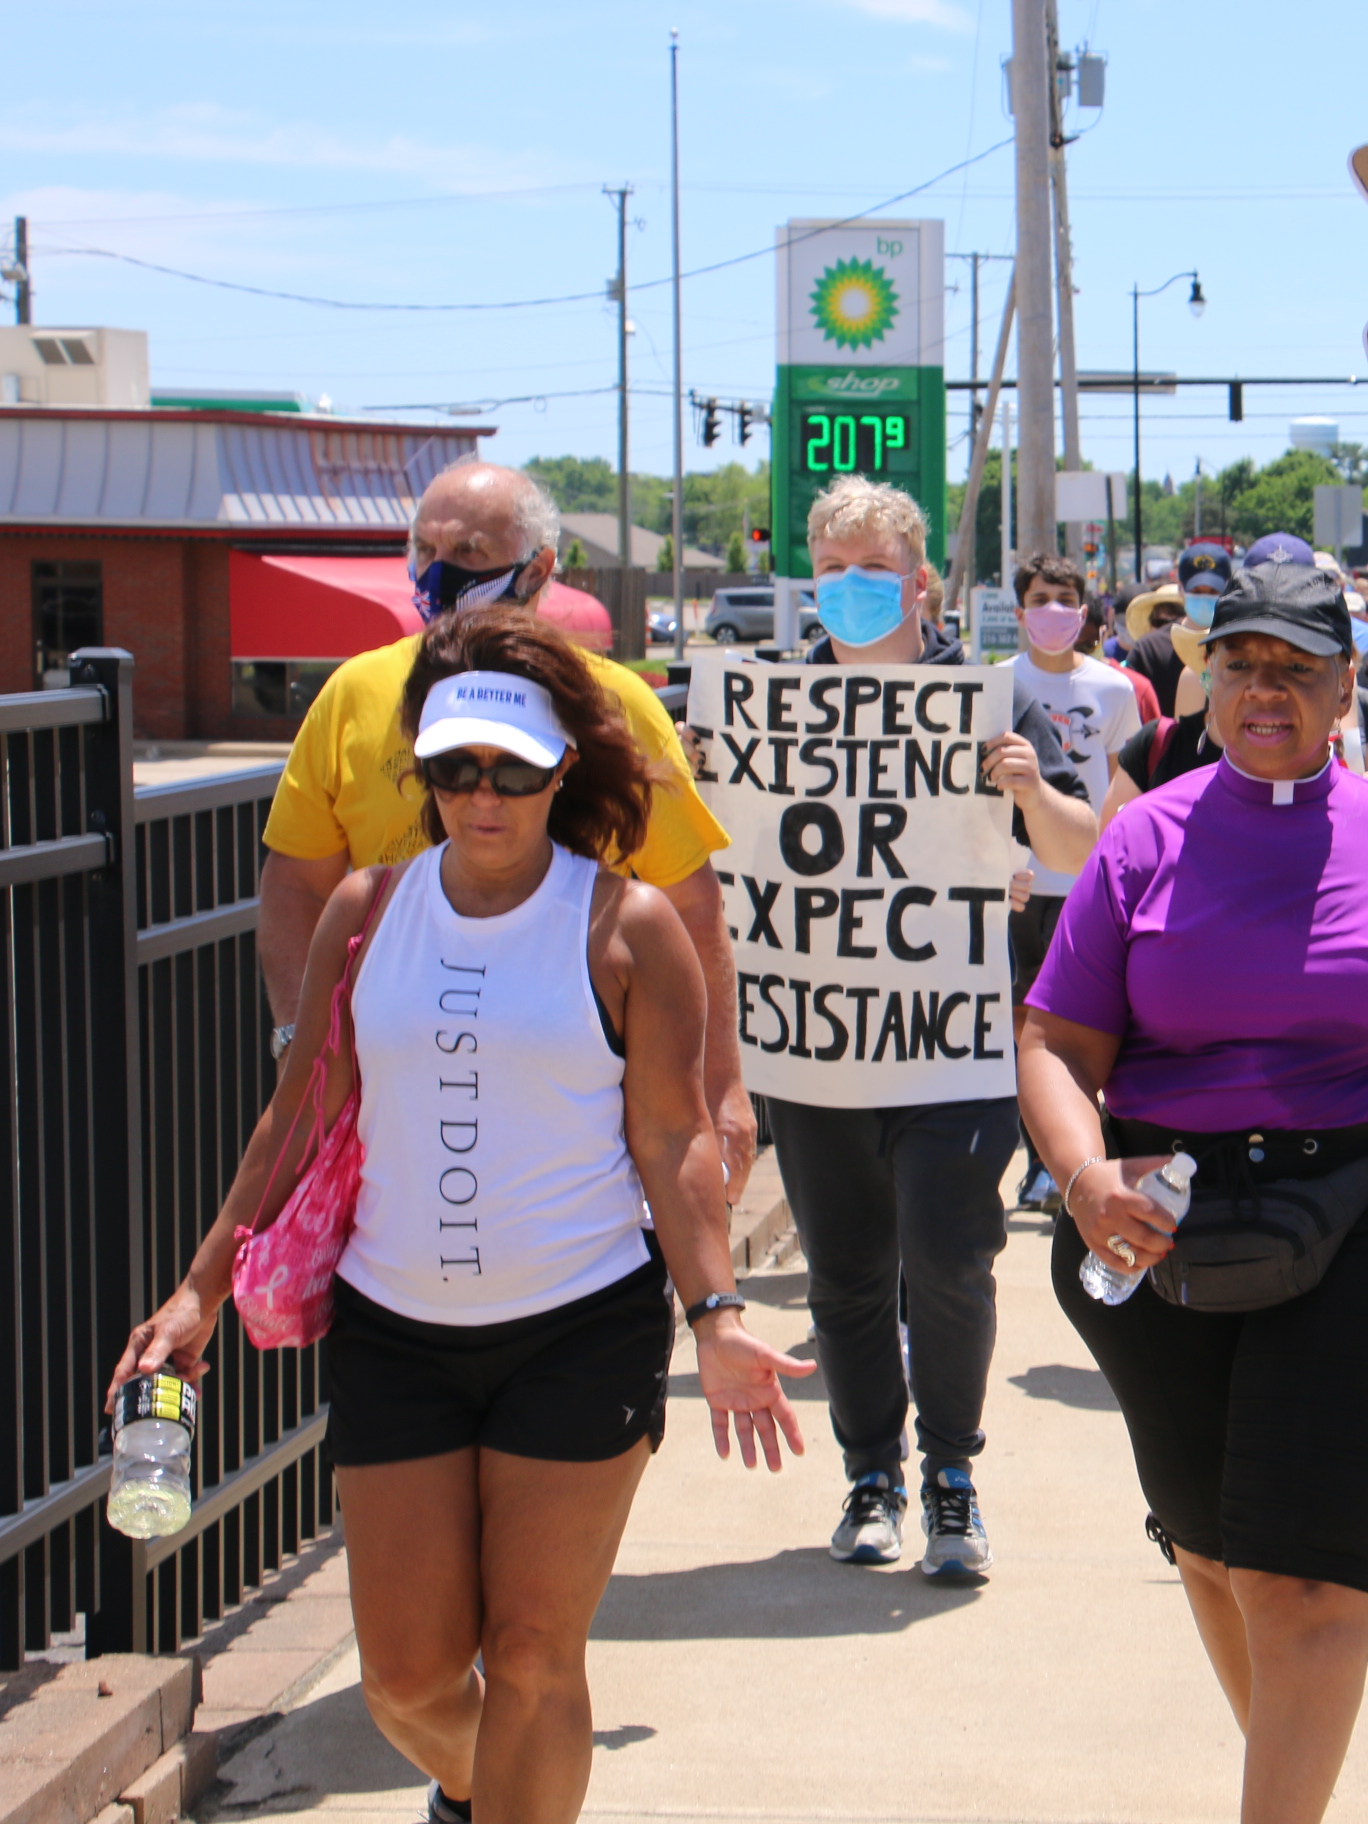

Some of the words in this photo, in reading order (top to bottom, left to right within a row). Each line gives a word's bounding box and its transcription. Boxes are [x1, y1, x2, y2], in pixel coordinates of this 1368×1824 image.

[877, 236, 904, 258] bp
[826, 371, 901, 398] shop
[477, 688, 512, 703] BETTER
[514, 692, 527, 707] ME
[724, 671, 984, 736] RESPECT
[779, 801, 909, 879] OR
[738, 971, 1004, 1062] ESISTANCE
